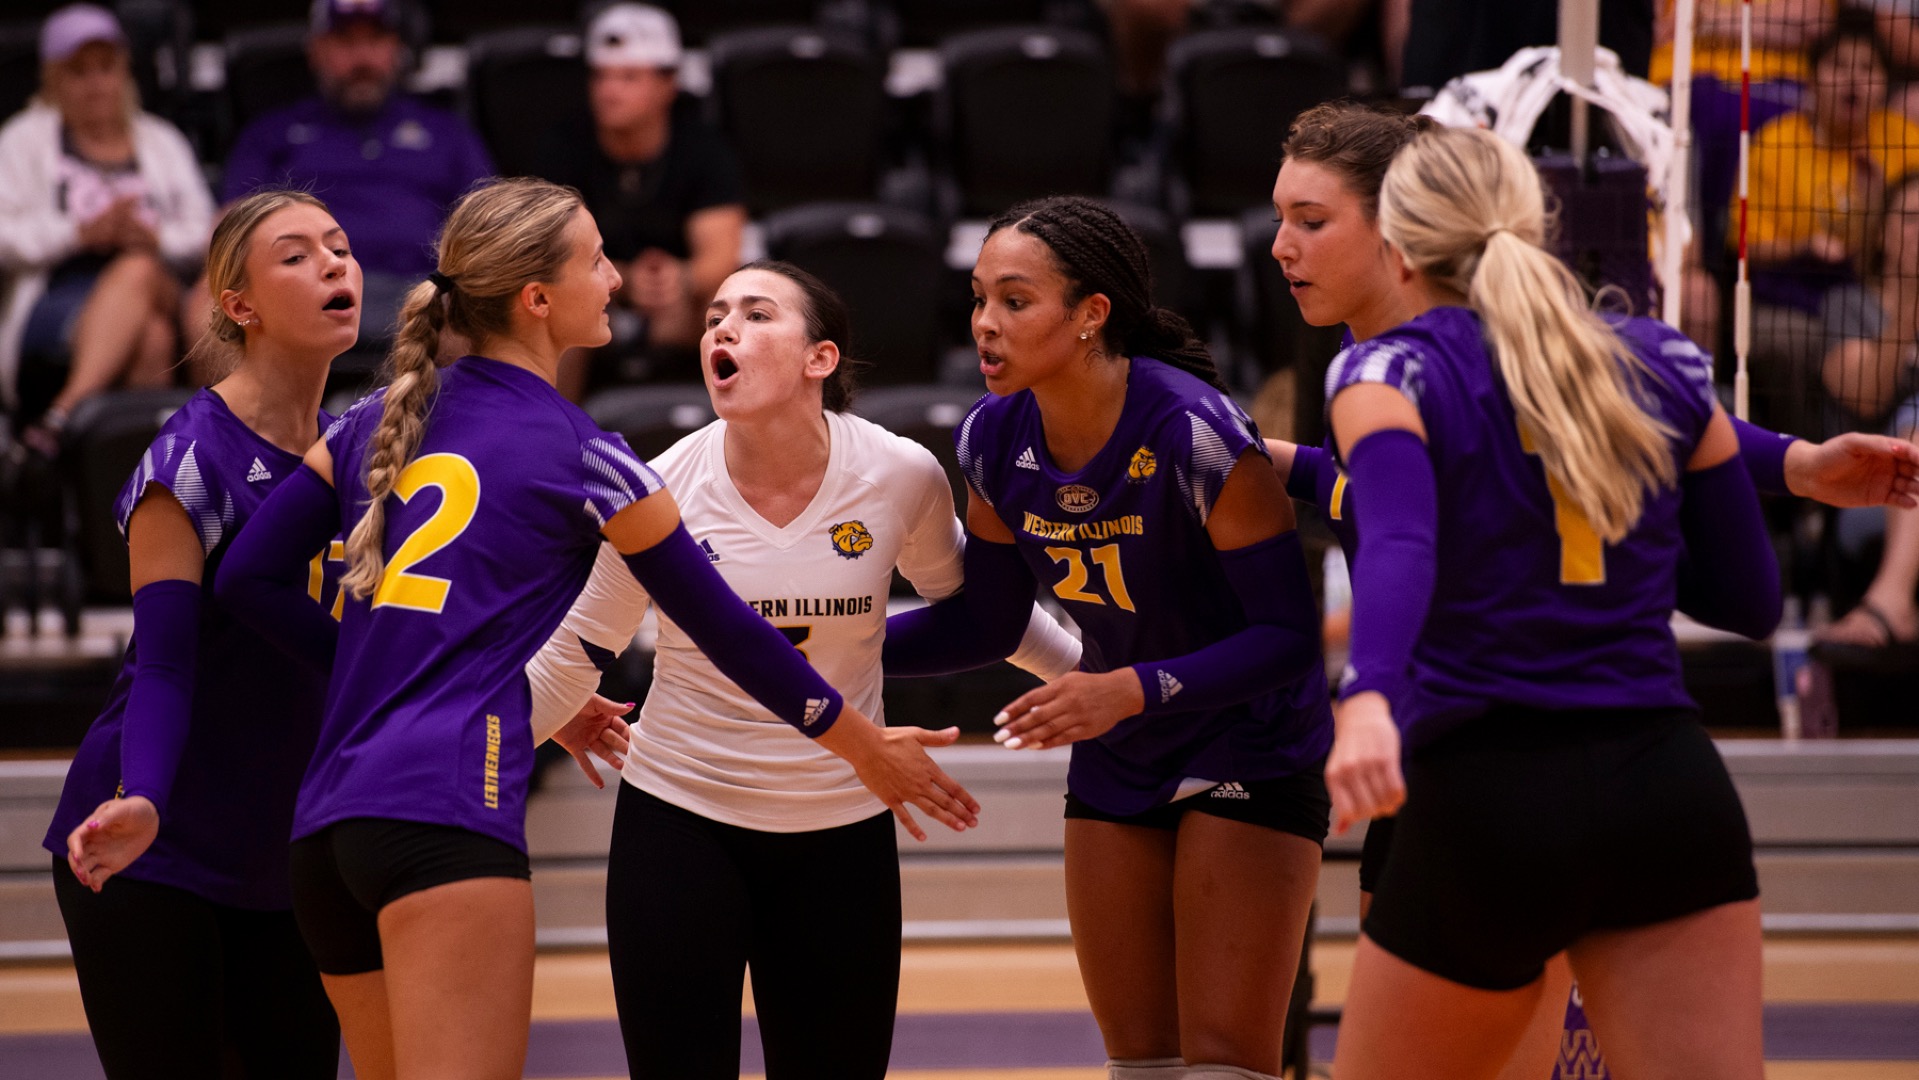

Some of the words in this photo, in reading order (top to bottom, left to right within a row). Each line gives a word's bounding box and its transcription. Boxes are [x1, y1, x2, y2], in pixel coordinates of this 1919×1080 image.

[246, 470, 272, 482] adidas
[1015, 459, 1040, 471] adidas
[1063, 492, 1089, 505] OVC
[371, 452, 481, 614] 2
[1022, 511, 1078, 541] WESTERN
[1078, 515, 1144, 540] ILLINOIS
[1044, 543, 1136, 613] 21
[795, 595, 872, 616] ILLINOIS
[803, 697, 830, 726] adidas
[484, 713, 501, 810] LEATHERNECKS
[1210, 789, 1250, 800] adidas
